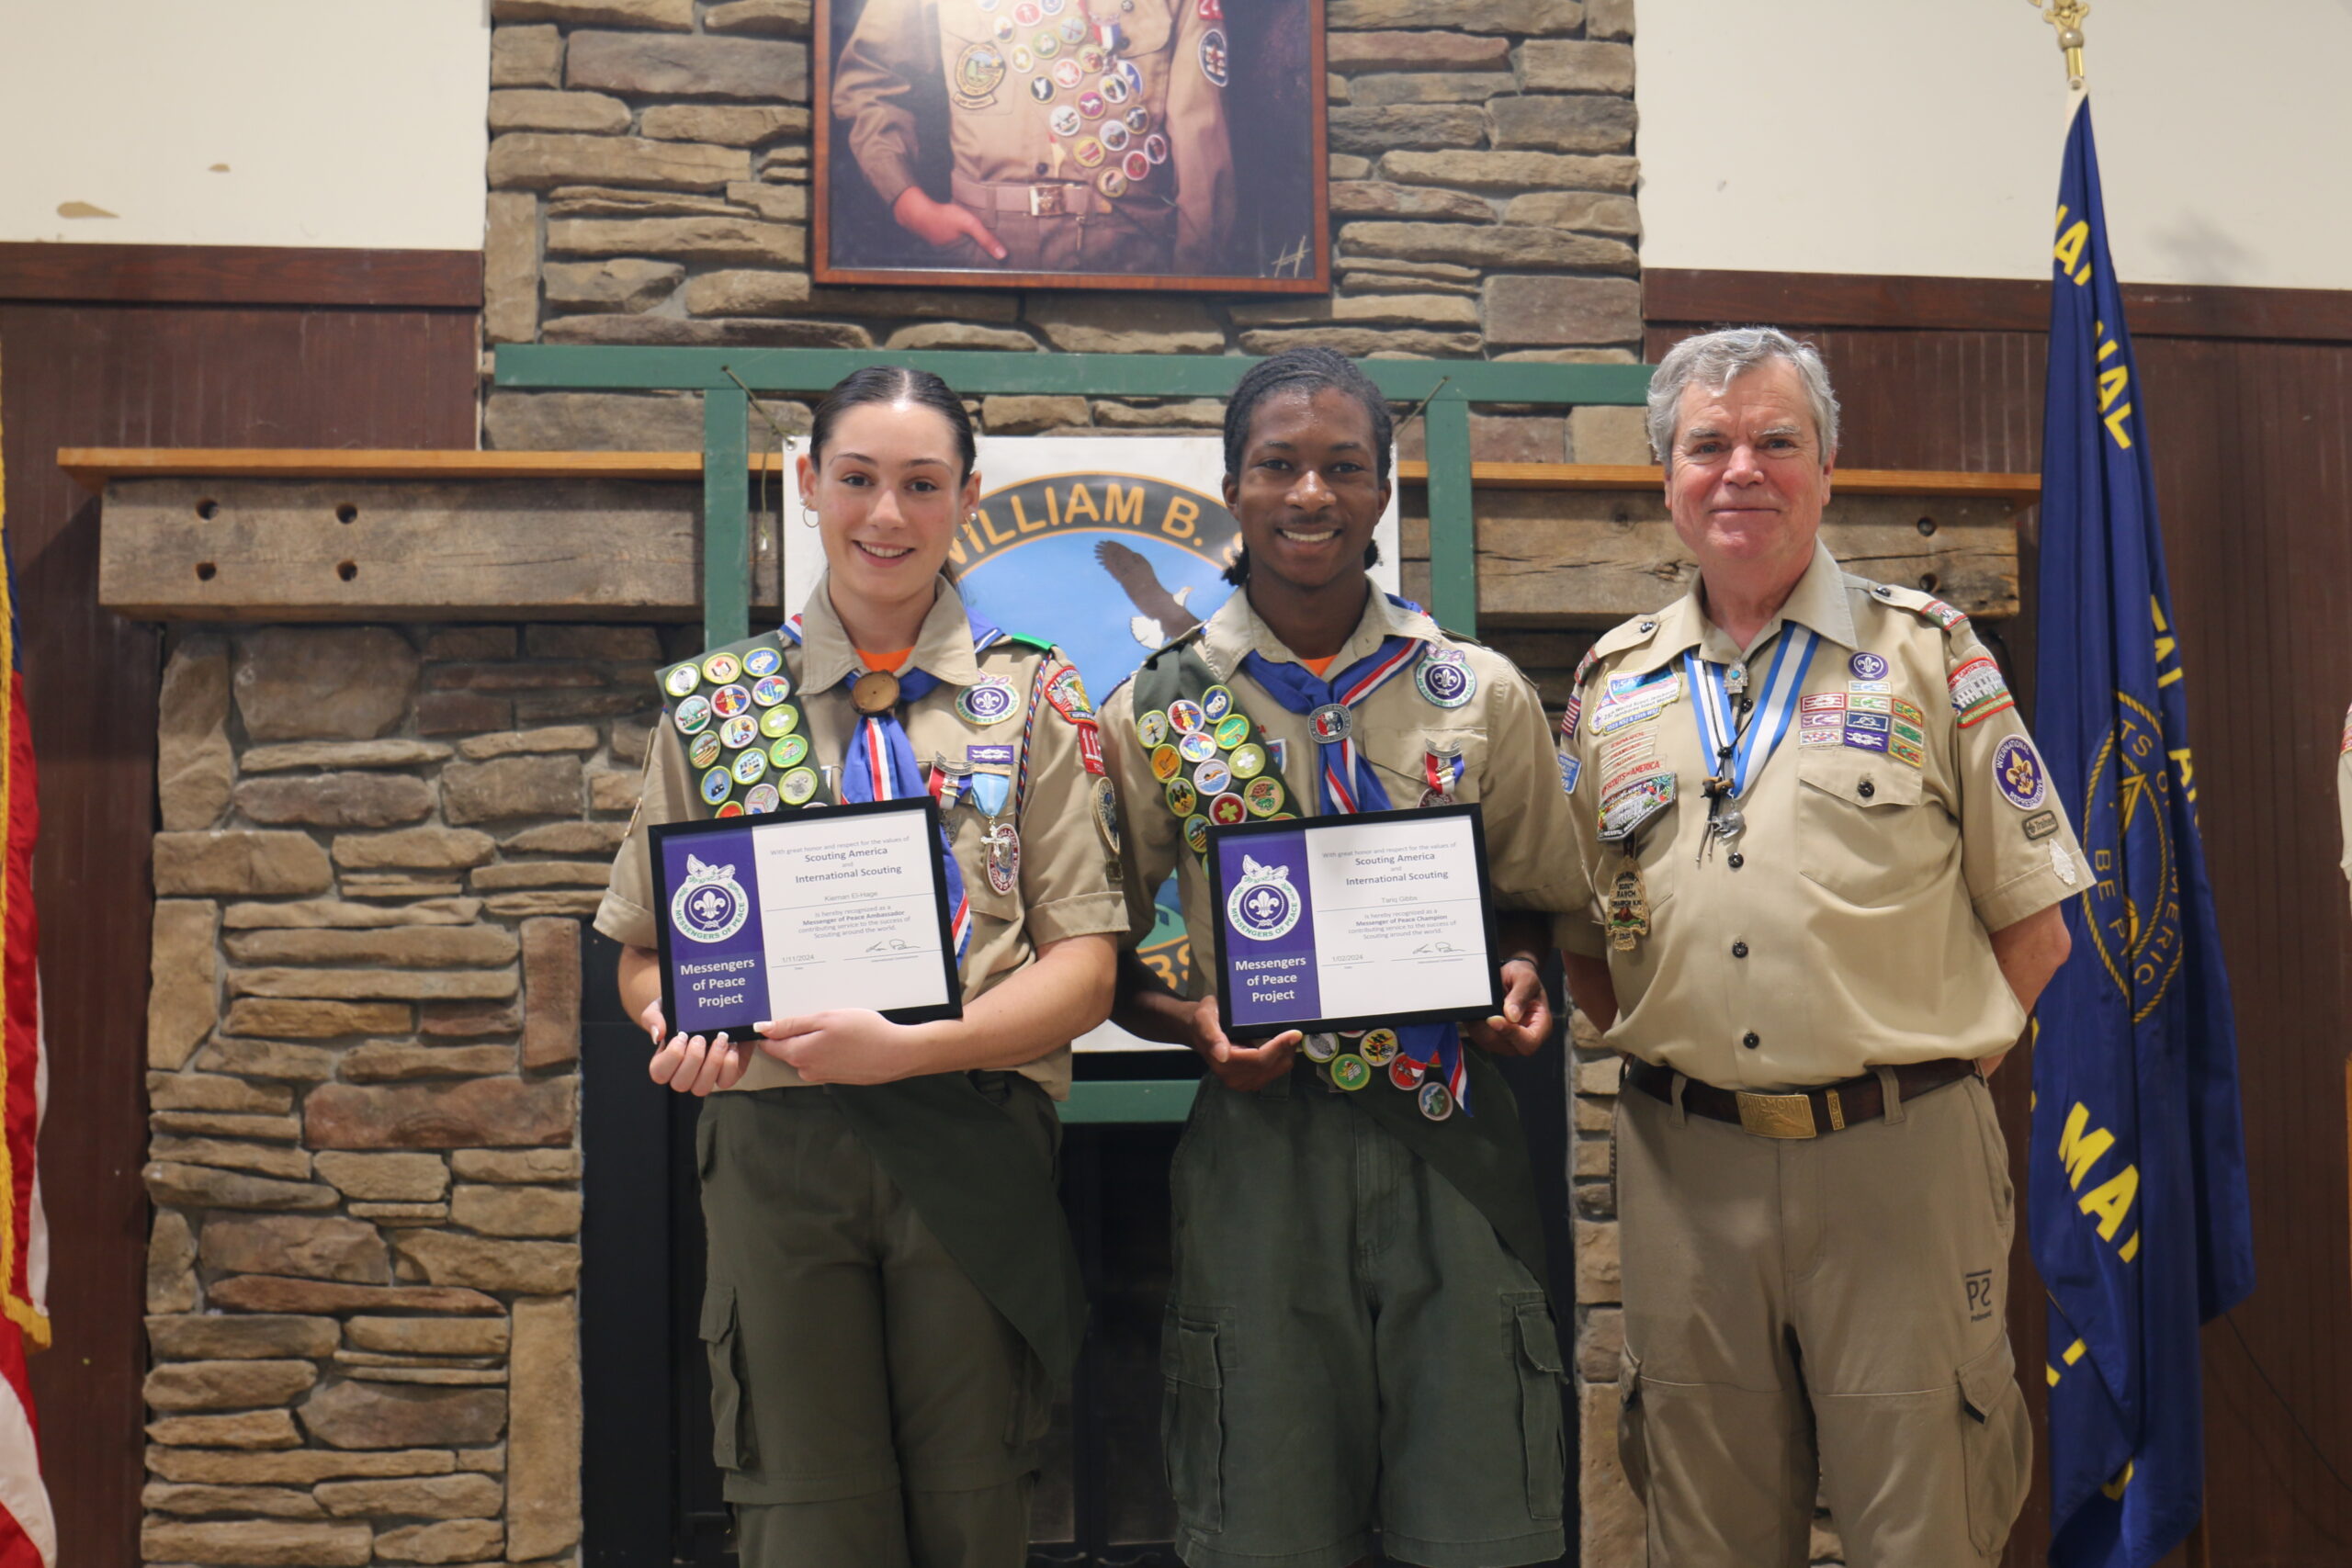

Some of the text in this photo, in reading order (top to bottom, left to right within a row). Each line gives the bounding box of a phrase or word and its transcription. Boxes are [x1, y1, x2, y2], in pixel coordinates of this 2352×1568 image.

[1161, 496, 1203, 547] B.
[1996, 739, 2030, 769] INTERNATIONAL
[837, 841, 859, 850] respect
[805, 847, 888, 863] Scouting America
[1355, 852, 1435, 865] Scouting America
[796, 865, 902, 884] International Scouting
[1346, 871, 1448, 886] International Scouting
[803, 918, 837, 928] Messenger
[846, 913, 865, 921] Peace
[866, 910, 905, 919] Ambassador
[821, 909, 843, 918] hereby
[844, 906, 878, 916] recognized
[1371, 911, 1392, 919] hereby
[1393, 909, 1424, 918] recognized
[675, 902, 745, 941] MESSENGERS OF PEACE
[1231, 902, 1297, 938] MESSENGERS OF PEACE
[1356, 919, 1388, 928] Messenger
[1417, 914, 1448, 922] Champion
[798, 924, 836, 933] contributing
[814, 931, 842, 940] Scouting
[842, 928, 865, 936] around
[1349, 926, 1384, 934] contributing
[680, 959, 755, 975] Messengers
[1235, 956, 1306, 971] Messengers
[693, 976, 746, 991] of Peace
[1247, 973, 1297, 986] of Peace
[698, 992, 743, 1009] Project
[1251, 988, 1295, 1003] Project
